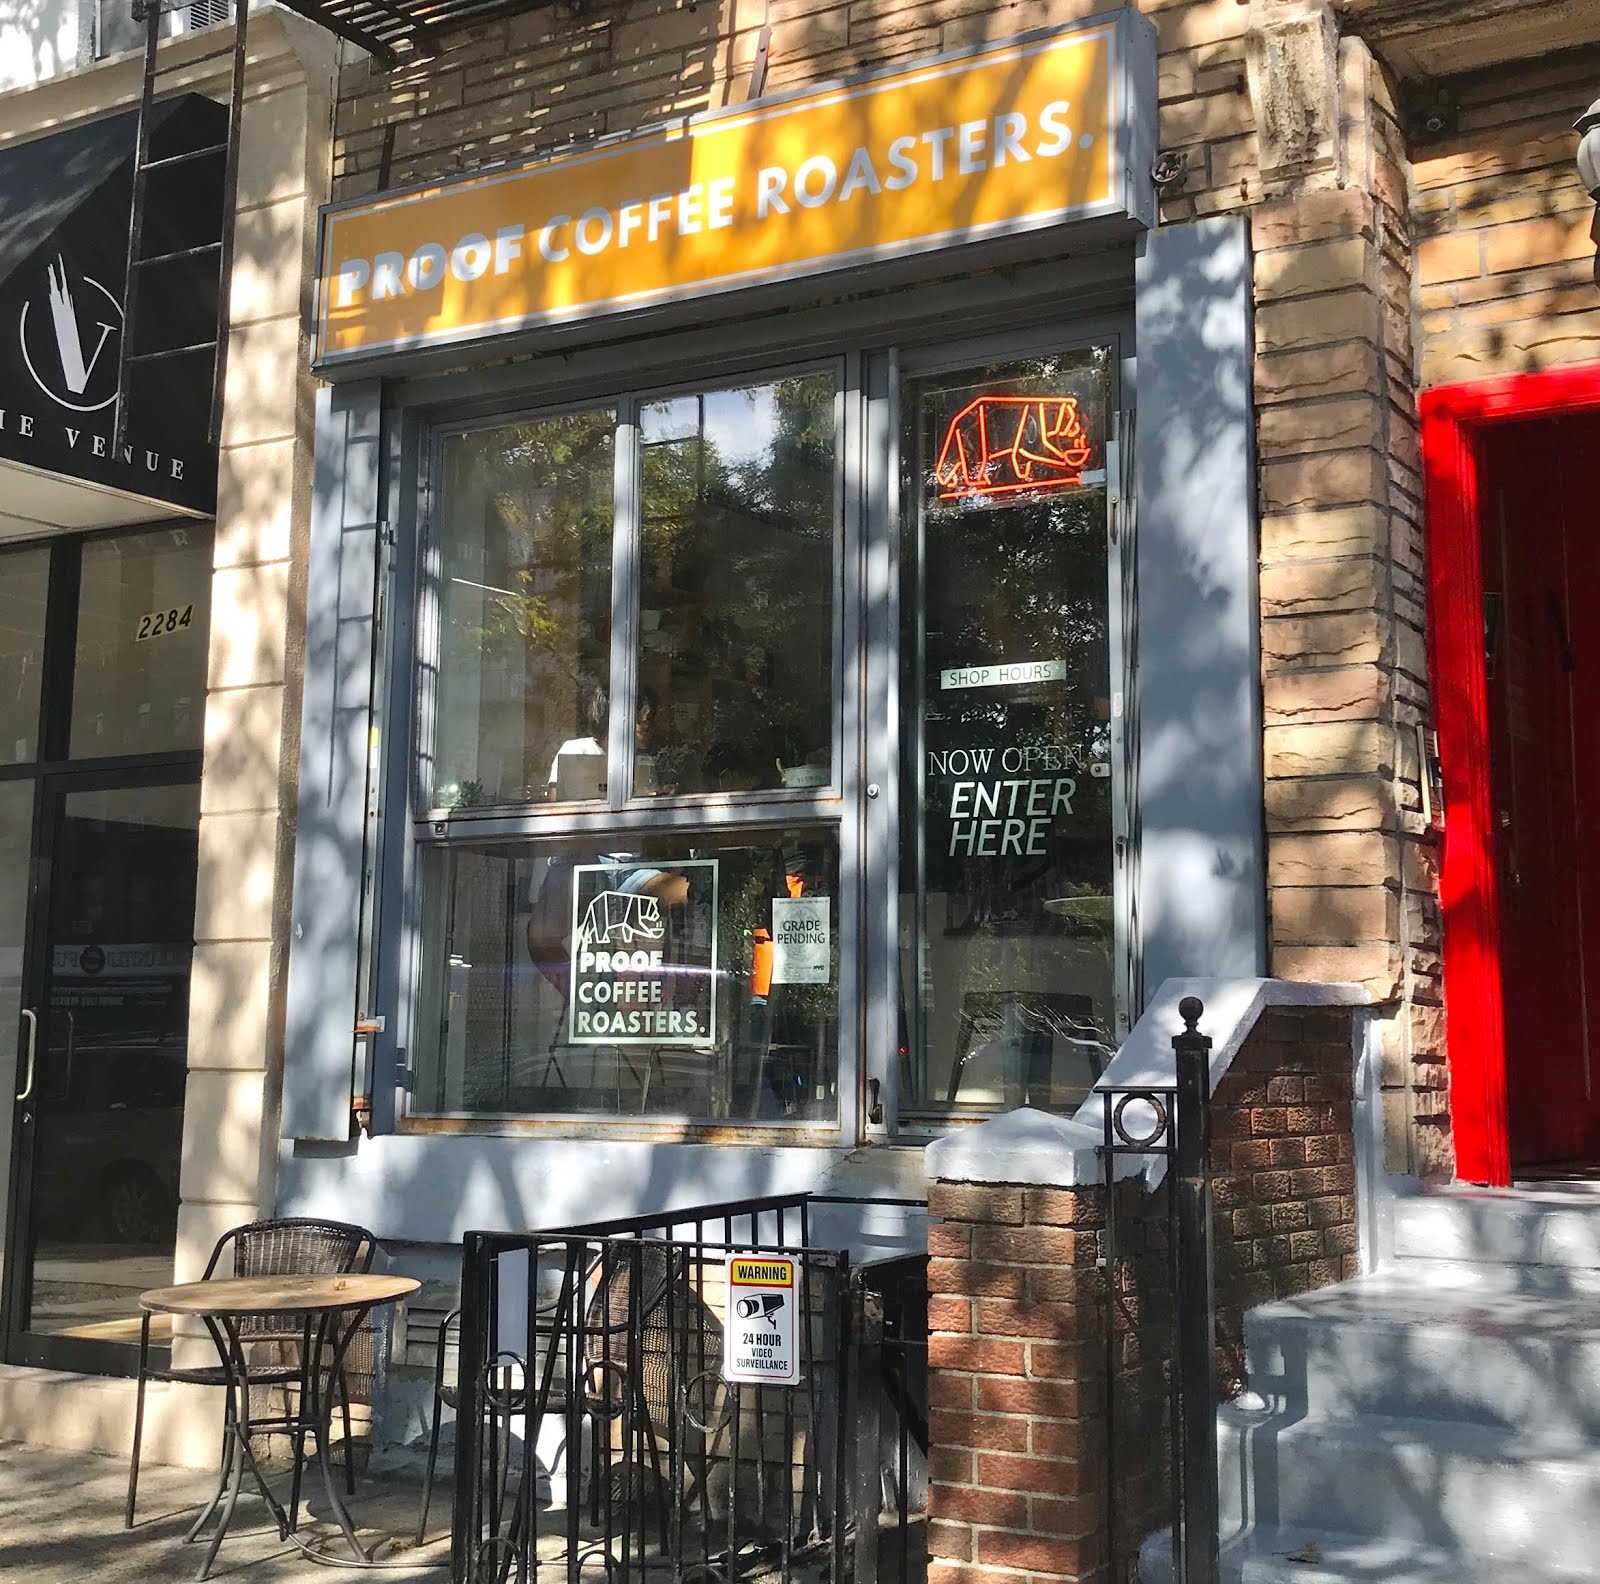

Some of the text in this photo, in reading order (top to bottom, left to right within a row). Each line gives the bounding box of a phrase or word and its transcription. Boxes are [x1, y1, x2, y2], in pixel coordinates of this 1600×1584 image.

[337, 100, 1094, 307] PROOF COFFEE ROASTERS.
[138, 604, 194, 639] 2284
[950, 664, 1051, 686] SHOP HOURS
[928, 744, 1084, 776] NOW OPEN
[949, 777, 1077, 819] ENTER
[948, 817, 1052, 857] HERE
[782, 920, 820, 932] GRADE
[777, 932, 826, 945] PENDING
[580, 951, 664, 973] PROOF
[578, 981, 662, 1004] COFFEE
[577, 1010, 706, 1034] ROASTERS.
[738, 1265, 787, 1281] WARNING
[743, 1333, 782, 1347] 24 HOUR
[736, 1358, 788, 1371] SURVEILLANCE
[751, 1348, 773, 1359] VIDEO
